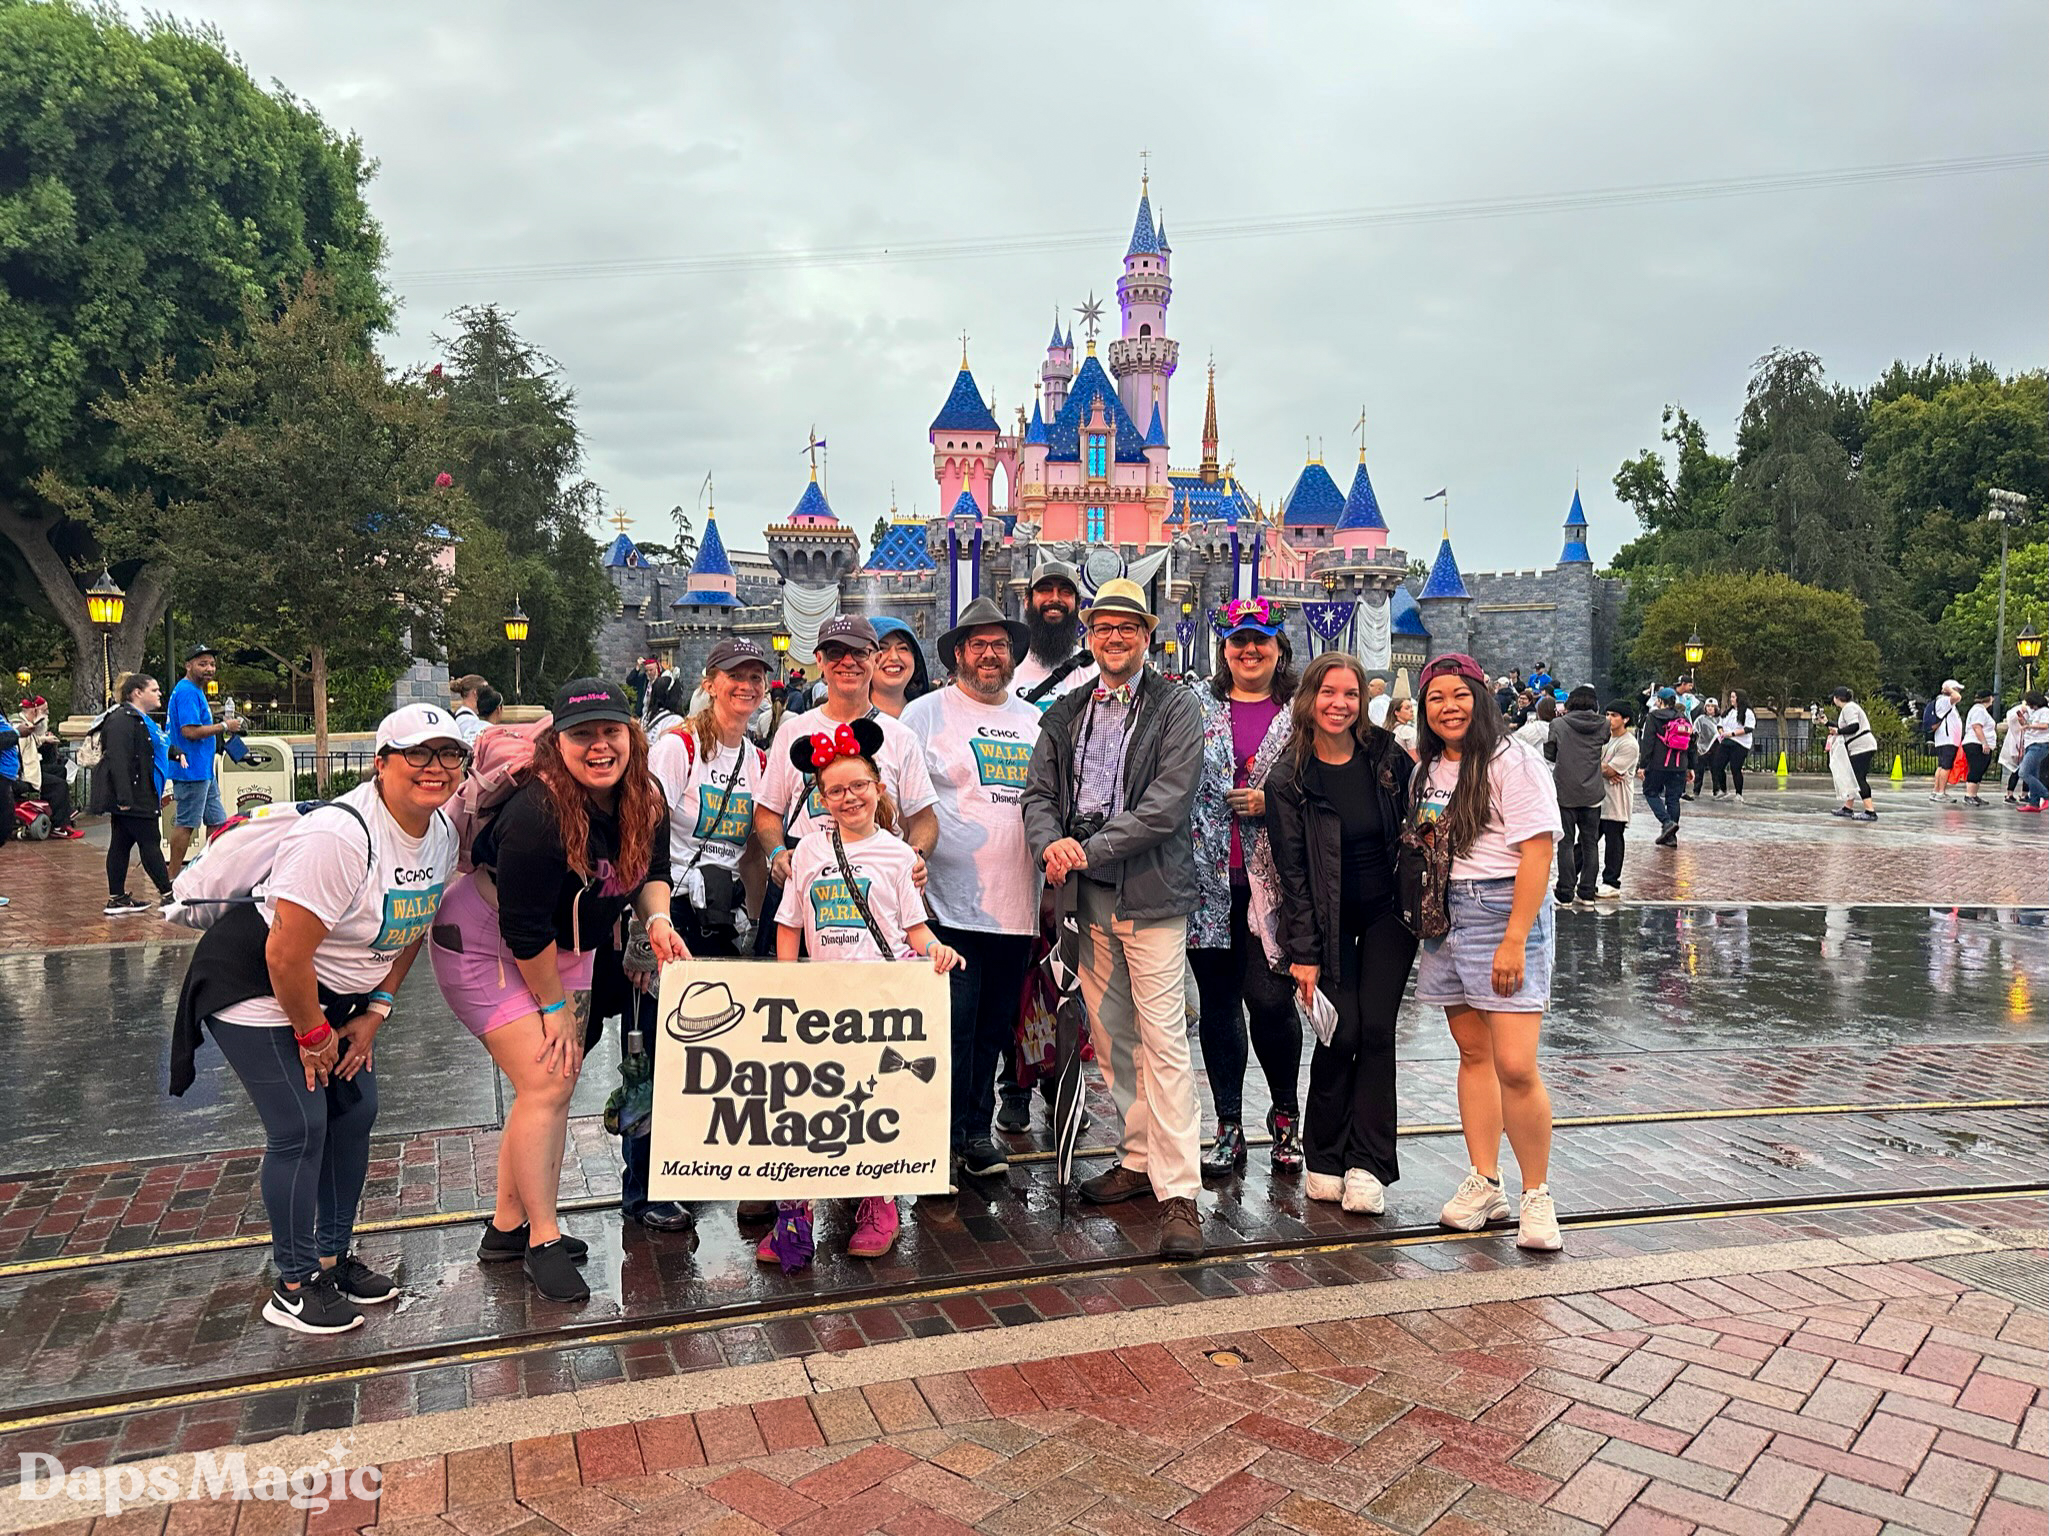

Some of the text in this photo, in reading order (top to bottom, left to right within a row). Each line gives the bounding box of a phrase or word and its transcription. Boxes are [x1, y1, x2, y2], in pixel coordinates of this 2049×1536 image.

[569, 695, 587, 704] Daps
[990, 729, 1020, 739] CHOC
[978, 743, 1030, 760] WALK
[1005, 758, 1017, 766] the
[1434, 790, 1452, 799] CH
[406, 867, 433, 882] CHOC
[393, 893, 439, 919] WALK
[821, 932, 860, 947] Disneyland
[753, 998, 927, 1044] Team
[682, 1046, 845, 1112] Daps
[703, 1096, 900, 1159] Magic
[661, 1158, 937, 1181] Making a difference together!
